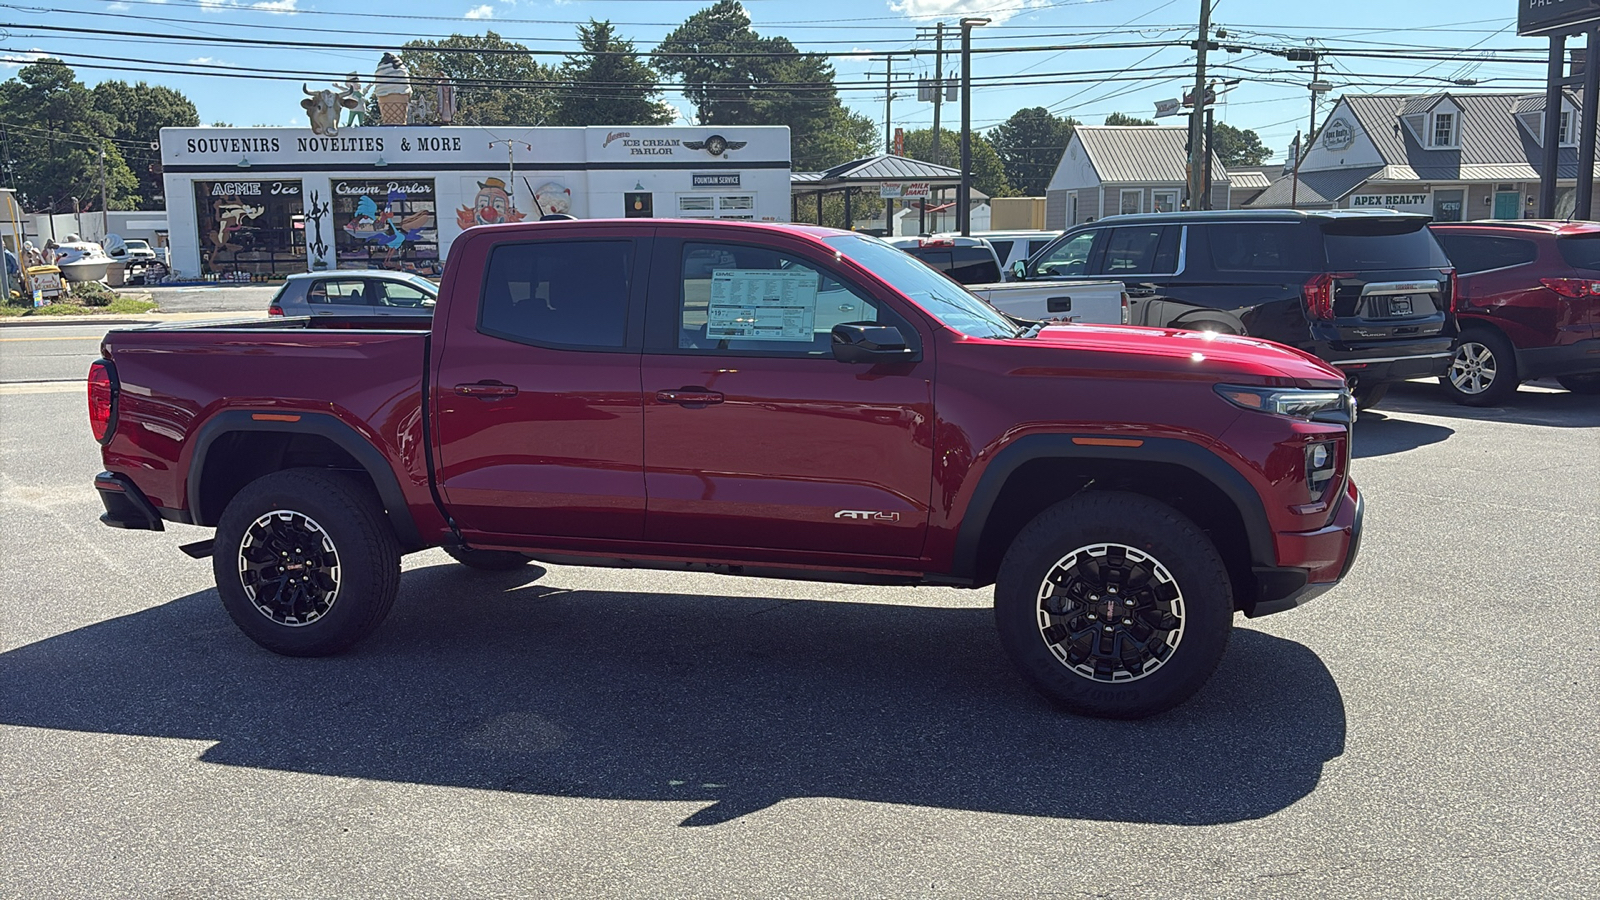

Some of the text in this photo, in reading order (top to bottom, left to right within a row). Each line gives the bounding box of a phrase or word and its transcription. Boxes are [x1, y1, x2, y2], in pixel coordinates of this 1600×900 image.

[187, 137, 461, 153] SOUVENIRS NOVELTIES & MORE
[623, 139, 680, 147] ICE CREAM
[630, 147, 673, 155] PARLOR
[694, 176, 739, 184] FOUNTAIN SERVICE
[212, 182, 300, 196] ACME Ice
[335, 180, 432, 194] Cream Parlor
[1354, 195, 1426, 206] APEX REALTY
[834, 509, 900, 523] AT4
